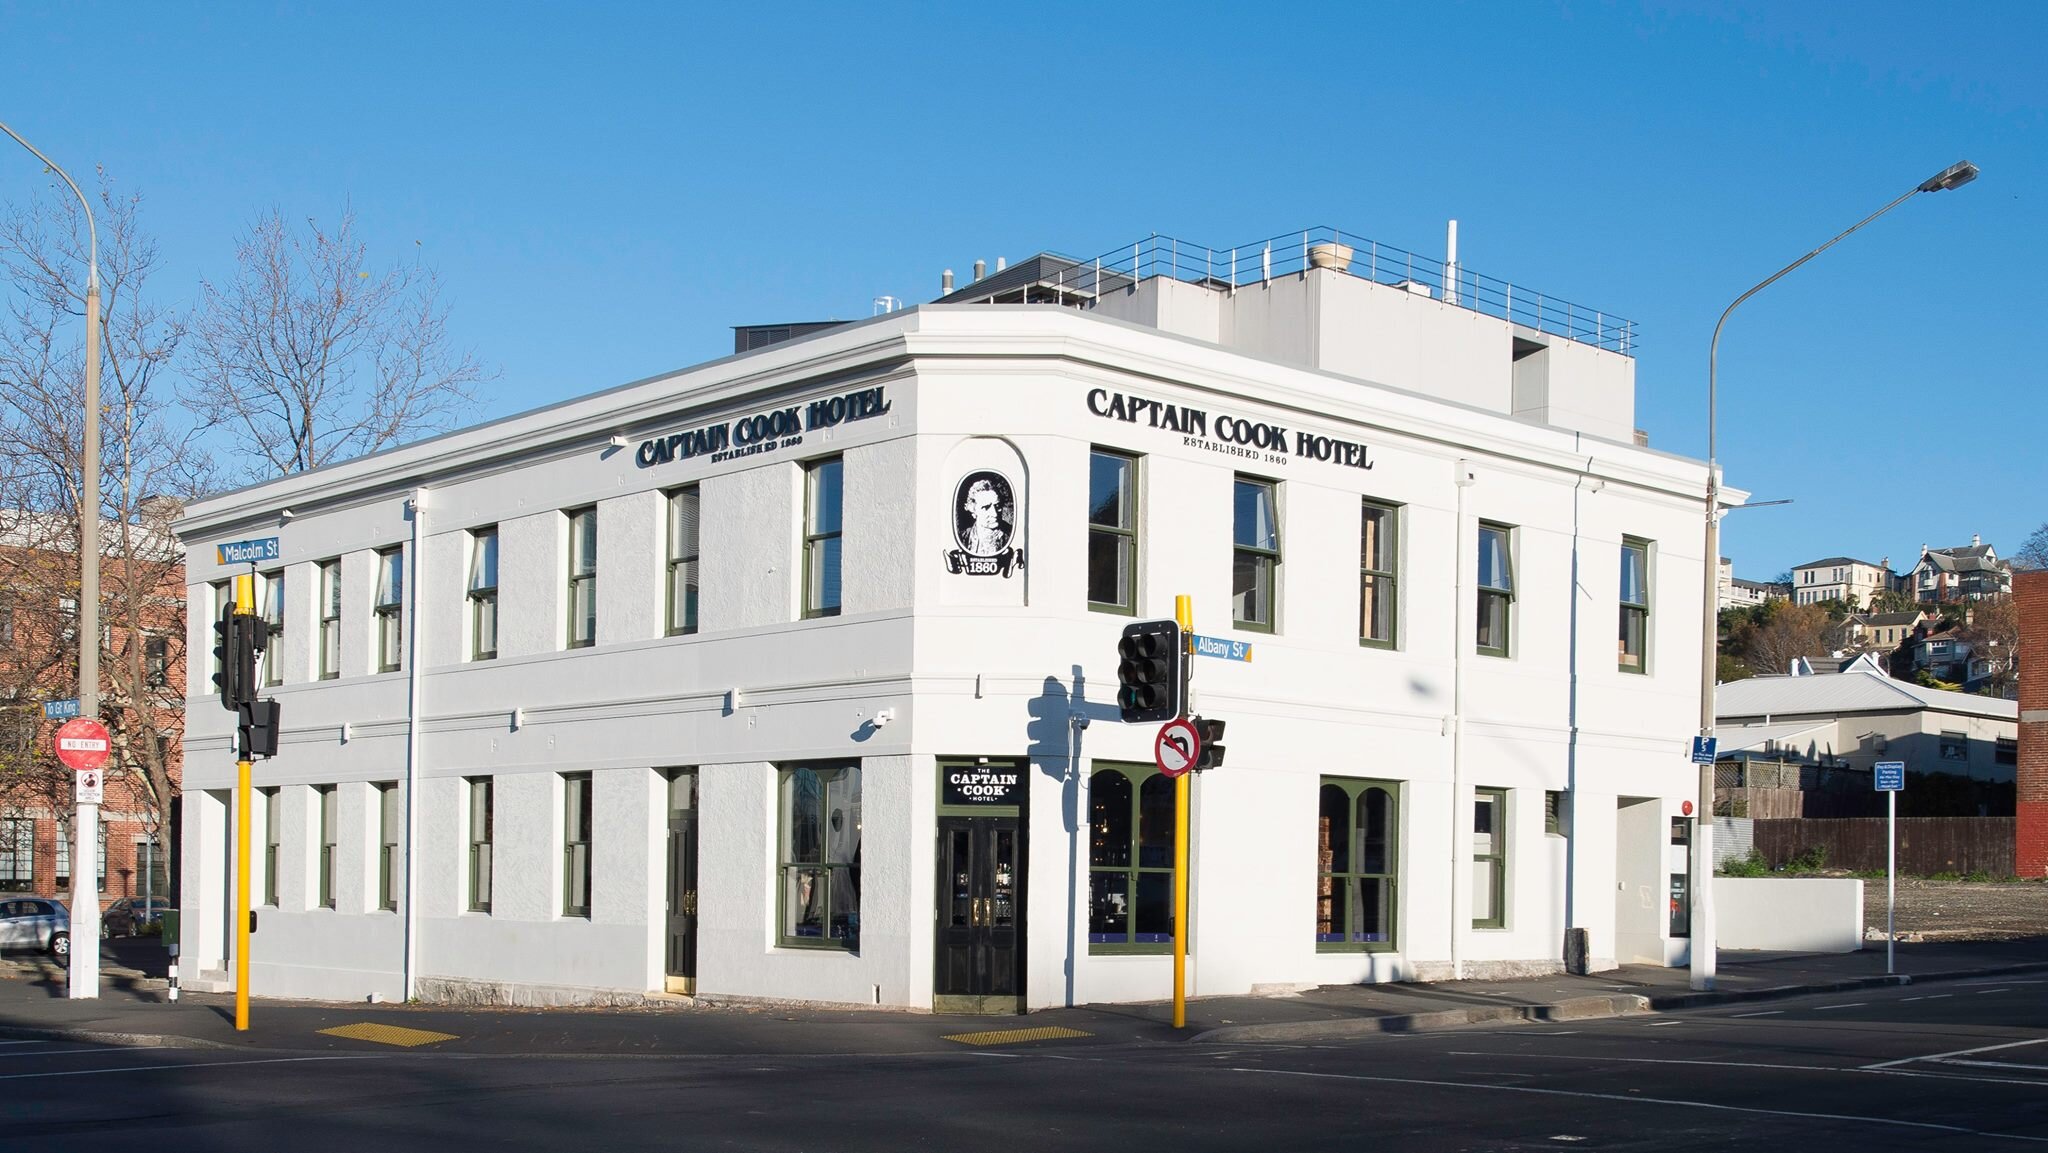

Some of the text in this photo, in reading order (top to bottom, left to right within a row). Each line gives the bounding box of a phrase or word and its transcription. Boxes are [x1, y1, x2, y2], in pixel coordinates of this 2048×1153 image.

[636, 386, 892, 469] CAPTAIN COOK HOTEL
[1087, 388, 1374, 470] CAPTAIN COOK HOTEL
[711, 436, 803, 464] ESTABLISHED 1860
[1183, 436, 1287, 466] ESTABLISHED 1860
[225, 540, 278, 562] Malcolm St
[969, 562, 998, 574] 1860
[1198, 637, 1244, 658] Albany St
[67, 740, 100, 749] NO ENTRY
[1701, 737, 1710, 745] P
[950, 773, 1018, 785] CAPTAIN
[962, 785, 1005, 796] COOK
